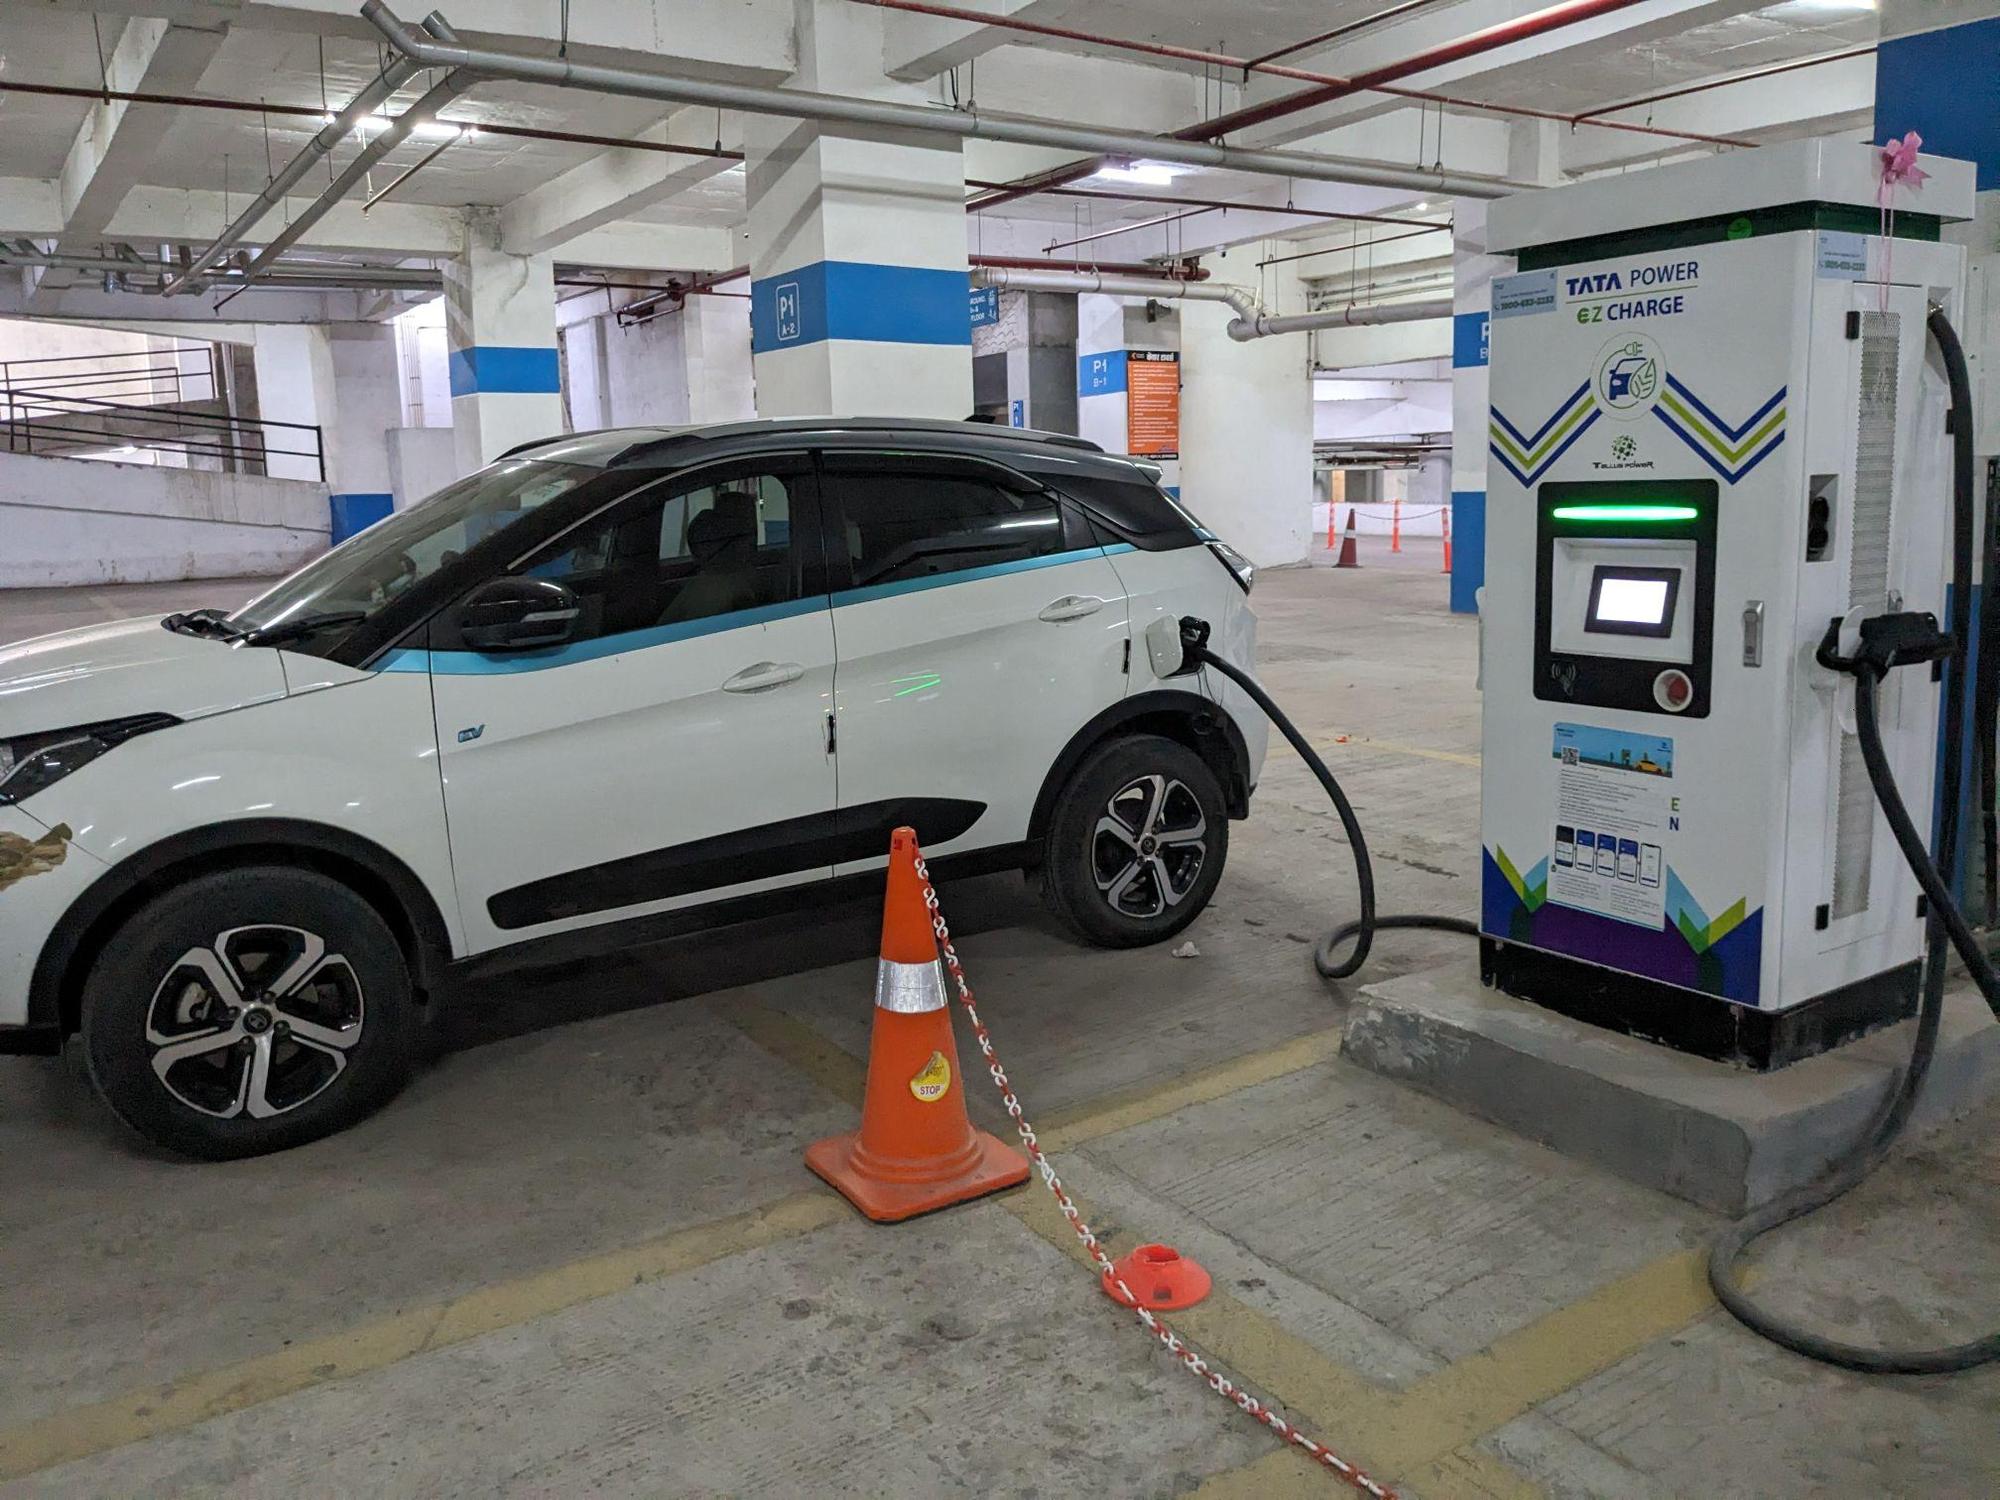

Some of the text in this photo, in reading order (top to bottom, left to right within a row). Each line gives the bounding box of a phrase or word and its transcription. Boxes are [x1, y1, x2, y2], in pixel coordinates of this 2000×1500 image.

[1565, 272, 1622, 296] TATA
[1630, 261, 1698, 287] POWER
[780, 294, 794, 320] P1
[1607, 296, 1684, 320] CHARGE
[782, 322, 796, 336] A-2
[1481, 321, 1490, 341] P
[1093, 359, 1107, 373] P1
[920, 1085, 941, 1095] STOP
